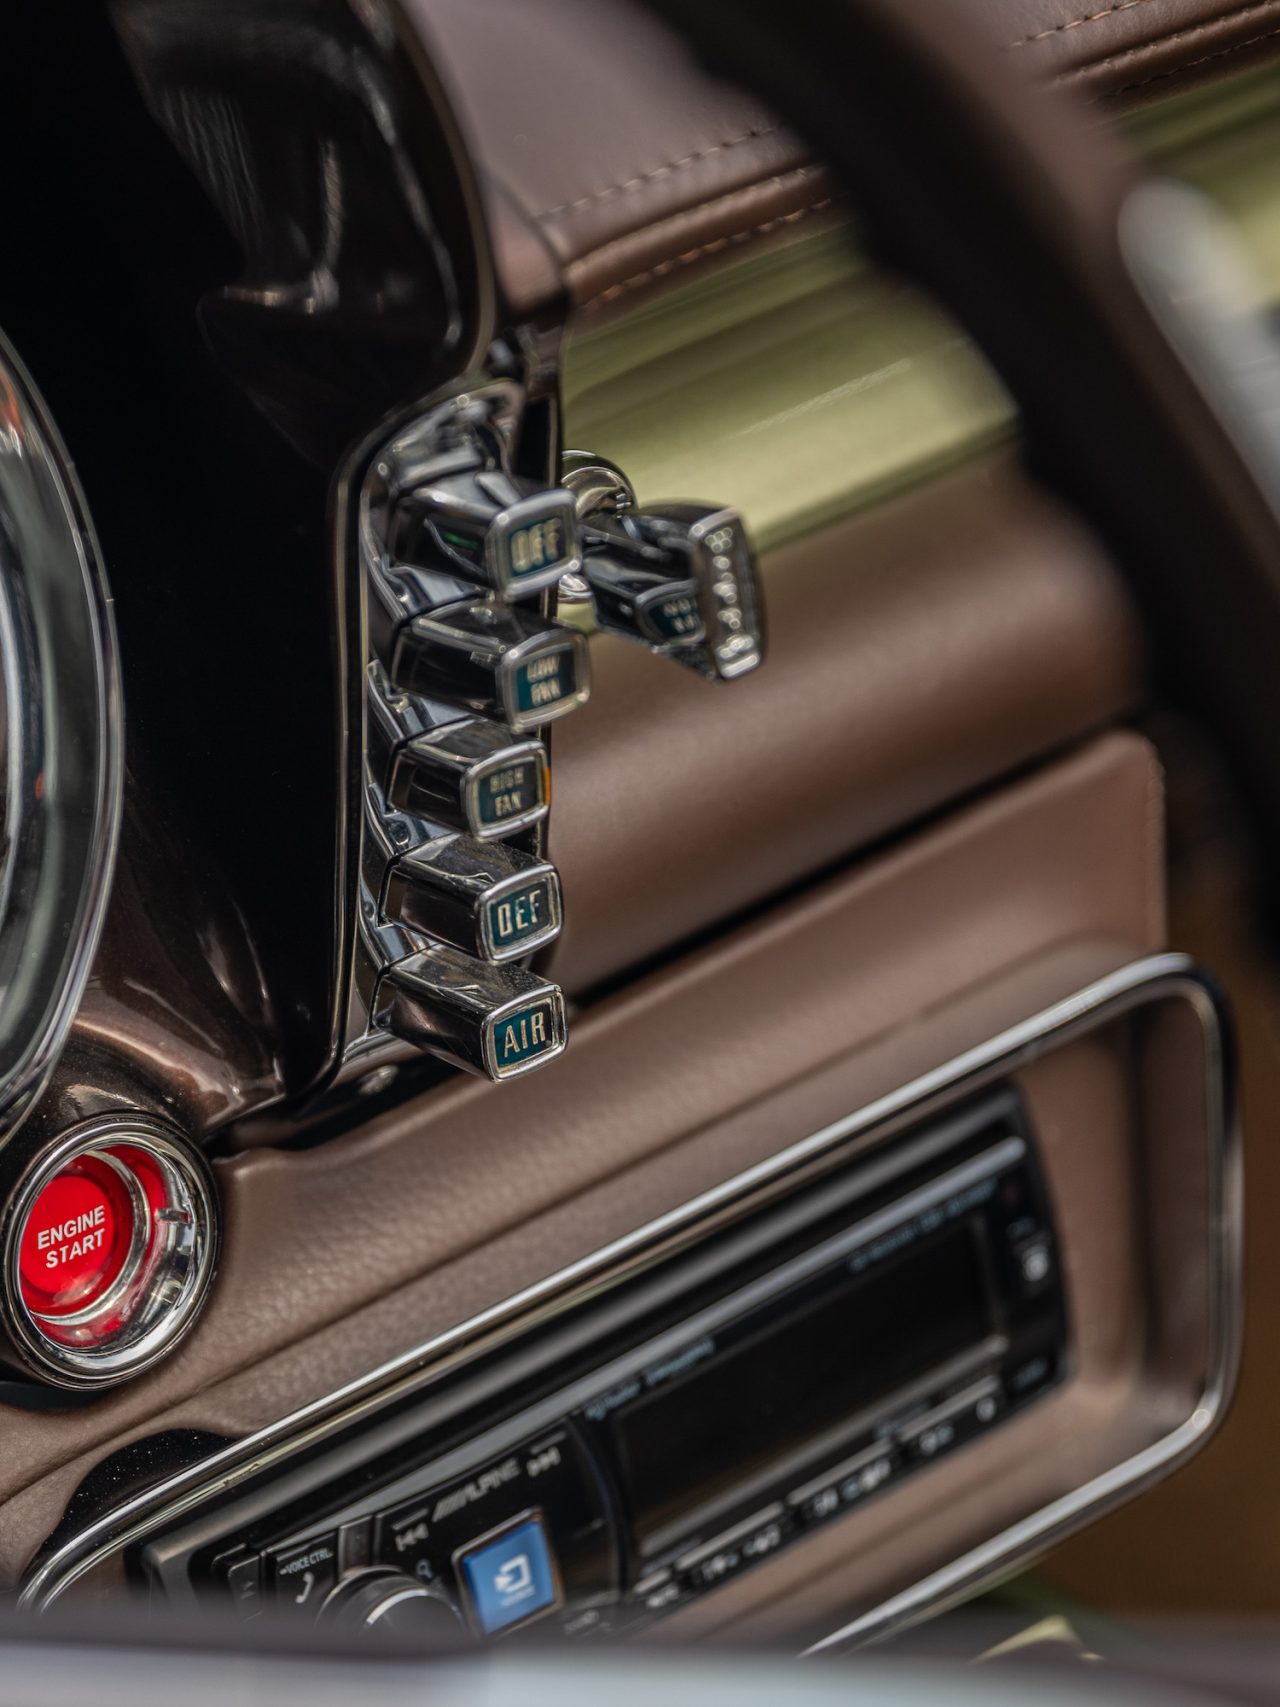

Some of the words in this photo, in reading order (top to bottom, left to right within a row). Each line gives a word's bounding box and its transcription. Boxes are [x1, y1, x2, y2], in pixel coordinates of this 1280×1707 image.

[510, 518, 562, 572] OFF
[526, 654, 560, 682] LOW
[489, 765, 525, 795] HIGH
[494, 792, 522, 818] FAN
[497, 888, 542, 938] DEF
[503, 1011, 546, 1058] AIR
[37, 1205, 106, 1250] ENGINE
[45, 1228, 106, 1269] START
[431, 1458, 520, 1523] ALPINE
[286, 1556, 311, 1574] VOICE
